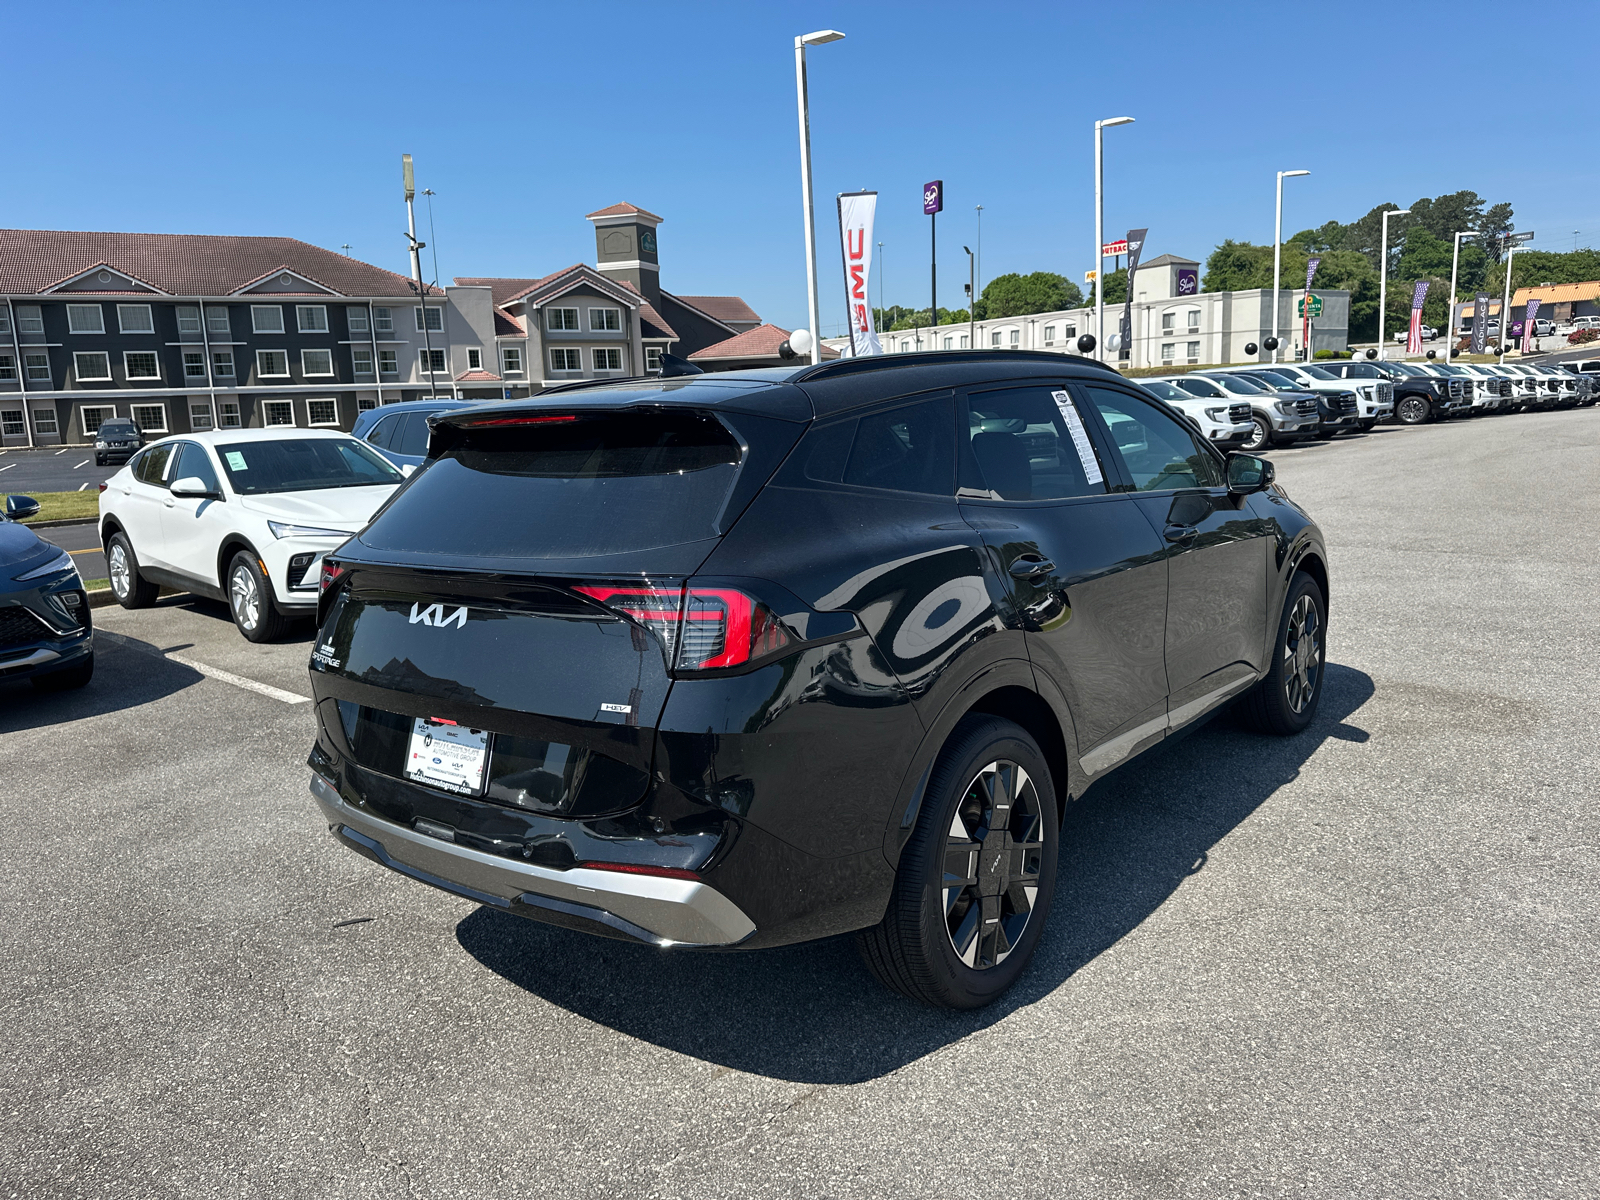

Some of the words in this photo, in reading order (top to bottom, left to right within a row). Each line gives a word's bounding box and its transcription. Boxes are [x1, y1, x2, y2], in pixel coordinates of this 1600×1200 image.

[1102, 244, 1127, 254] UTBAC
[847, 228, 869, 333] GMC
[1477, 304, 1487, 352] CADILLAC
[408, 601, 468, 629] KIA
